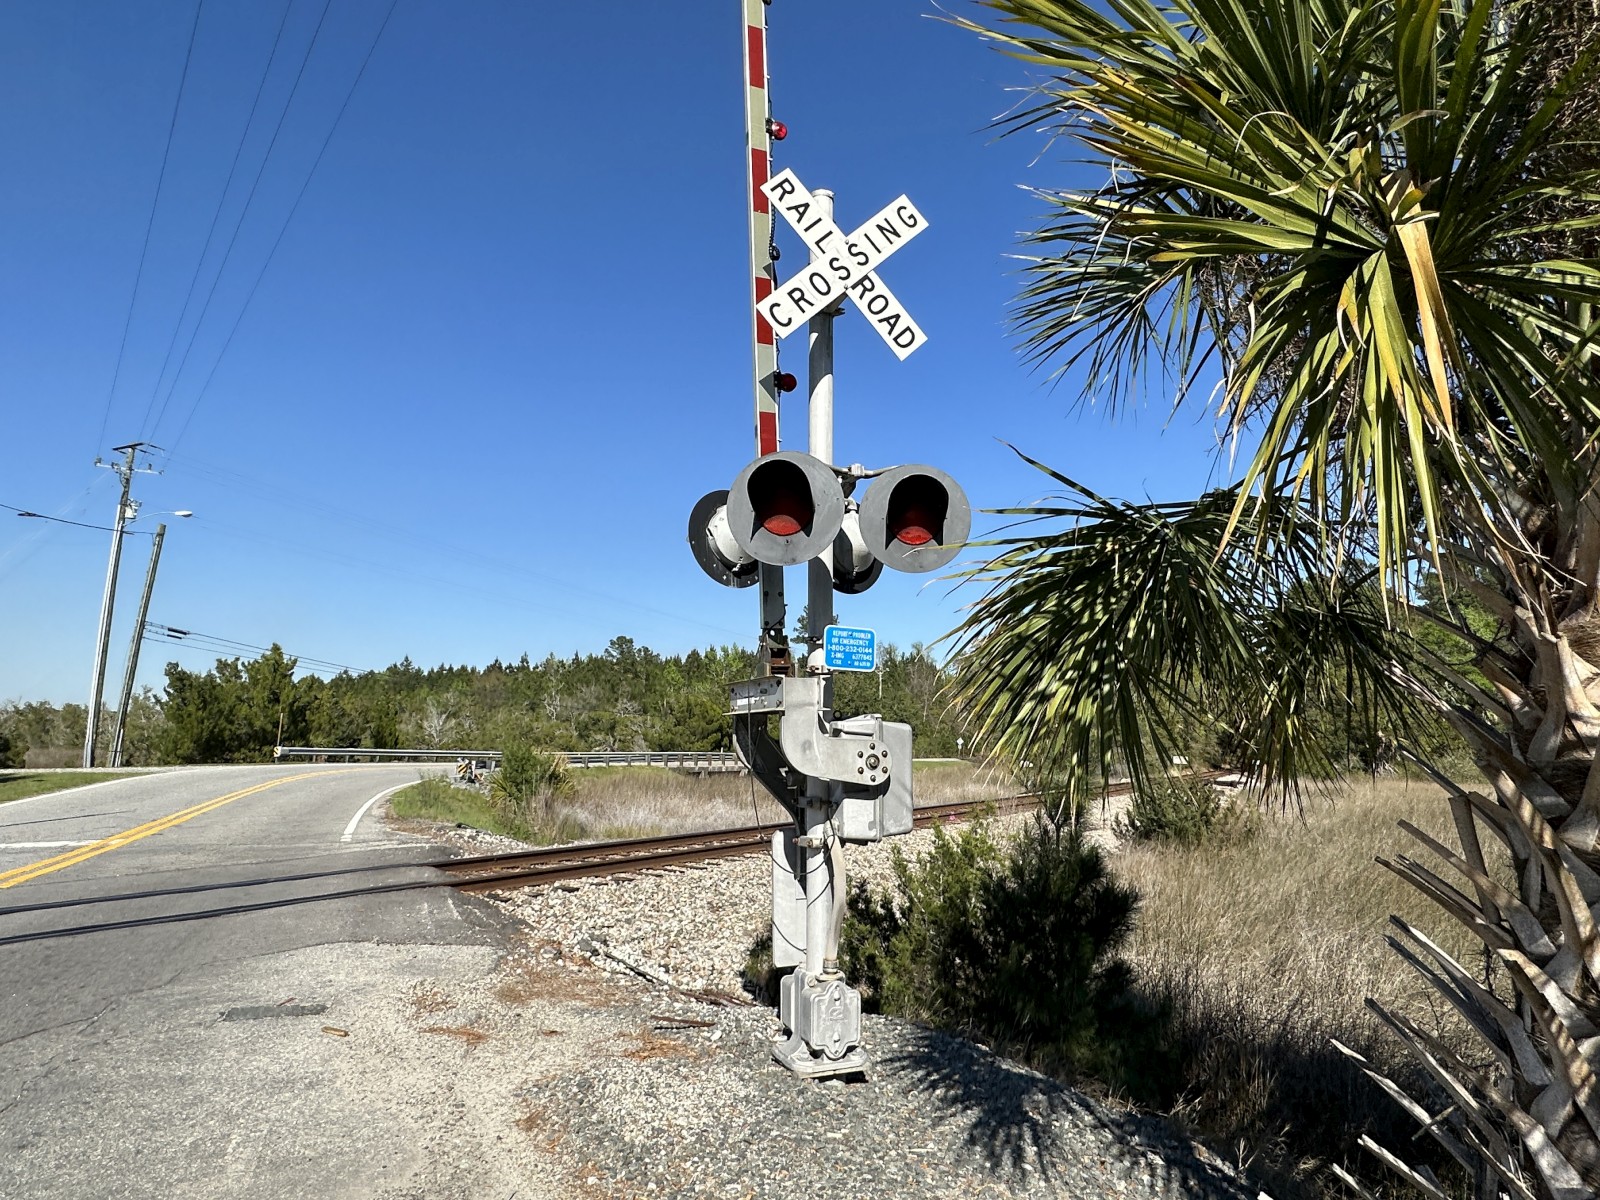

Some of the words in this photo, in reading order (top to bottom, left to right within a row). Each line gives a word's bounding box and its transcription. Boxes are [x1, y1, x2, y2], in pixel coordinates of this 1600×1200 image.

[769, 205, 918, 327] CROSSING
[770, 177, 833, 254] RAIL
[850, 274, 916, 349] ROAD
[828, 644, 872, 653] 1-800-232-0144
[840, 638, 869, 646] EMERGENCY
